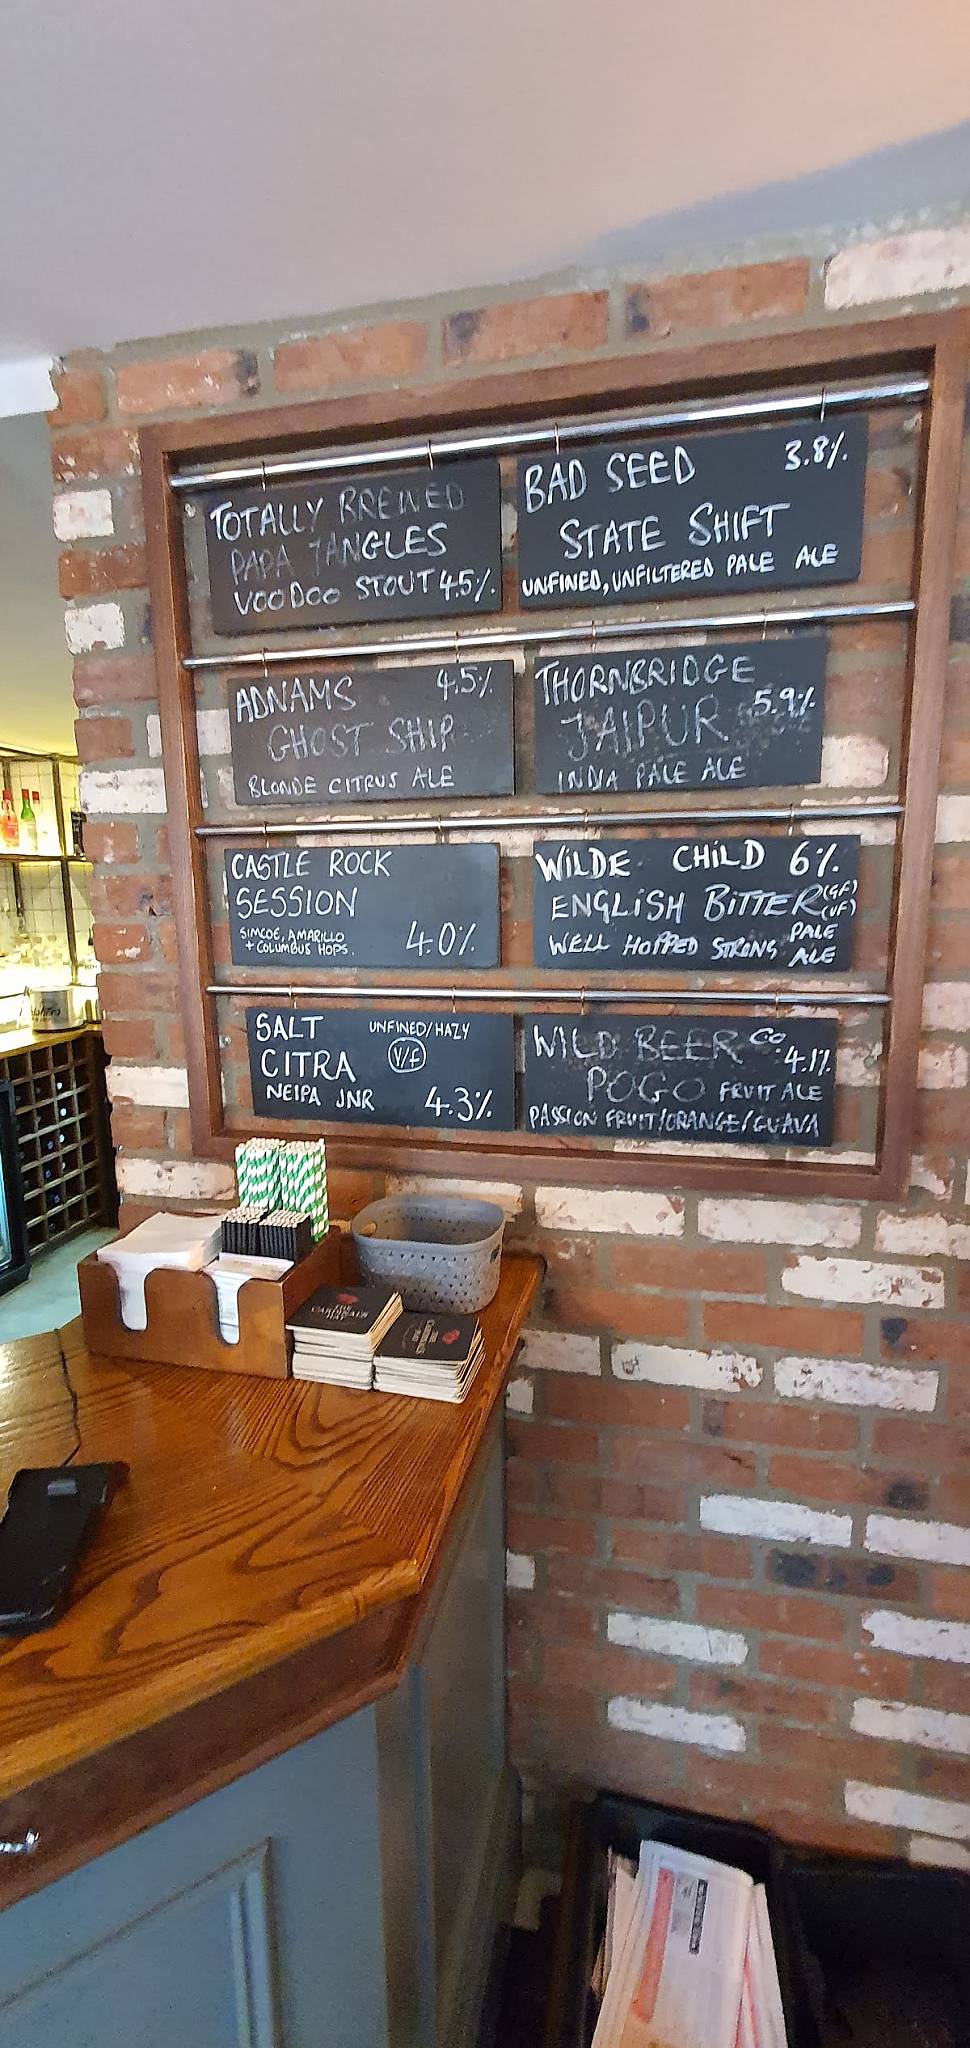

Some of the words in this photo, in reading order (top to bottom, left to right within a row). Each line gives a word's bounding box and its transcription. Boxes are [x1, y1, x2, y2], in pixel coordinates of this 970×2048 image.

[784, 430, 848, 471] 3.8%
[525, 458, 588, 514] BAD
[605, 445, 696, 493] SEED
[210, 497, 324, 541] TOTALLY
[559, 516, 667, 560] STATE
[688, 502, 791, 547] SHIFT
[726, 551, 776, 576] PALE
[795, 543, 839, 570] ALE
[233, 580, 341, 616] VOODOO
[355, 568, 435, 601] STOUT
[534, 653, 756, 706] THORNBRIDGE
[236, 675, 357, 723] ADNAMS
[267, 722, 375, 762] GHOST
[385, 714, 455, 754] SHIP
[560, 693, 729, 762] JAIPUR
[249, 775, 317, 799] BLONDE
[328, 771, 398, 794] CITRUS
[411, 765, 456, 788] ALE
[635, 760, 690, 790] PALE
[701, 756, 747, 782] ALE
[231, 850, 312, 881] CASTLE
[329, 849, 392, 877] ROCK
[788, 841, 840, 878] 6%
[236, 885, 358, 919] SESSION
[256, 941, 312, 956] COLUMBUS
[288, 927, 345, 944] AMARILLO
[405, 920, 476, 957] 4.0%
[548, 932, 611, 956] WELL
[622, 930, 699, 957] HOPPED
[788, 920, 839, 943] PALE
[787, 945, 837, 968] ALE
[255, 1012, 324, 1042] SALT
[533, 1024, 617, 1058] WILD
[634, 1024, 744, 1064] BEER
[260, 1049, 357, 1083] CITRA
[266, 1083, 322, 1107] NEIPA
[335, 1089, 375, 1112] JNR
[587, 1065, 707, 1104] POGO
[719, 1081, 776, 1102] FRUIT
[783, 1081, 823, 1102] ALE
[424, 1086, 494, 1122] 4.3%
[528, 1103, 597, 1130] PASSION
